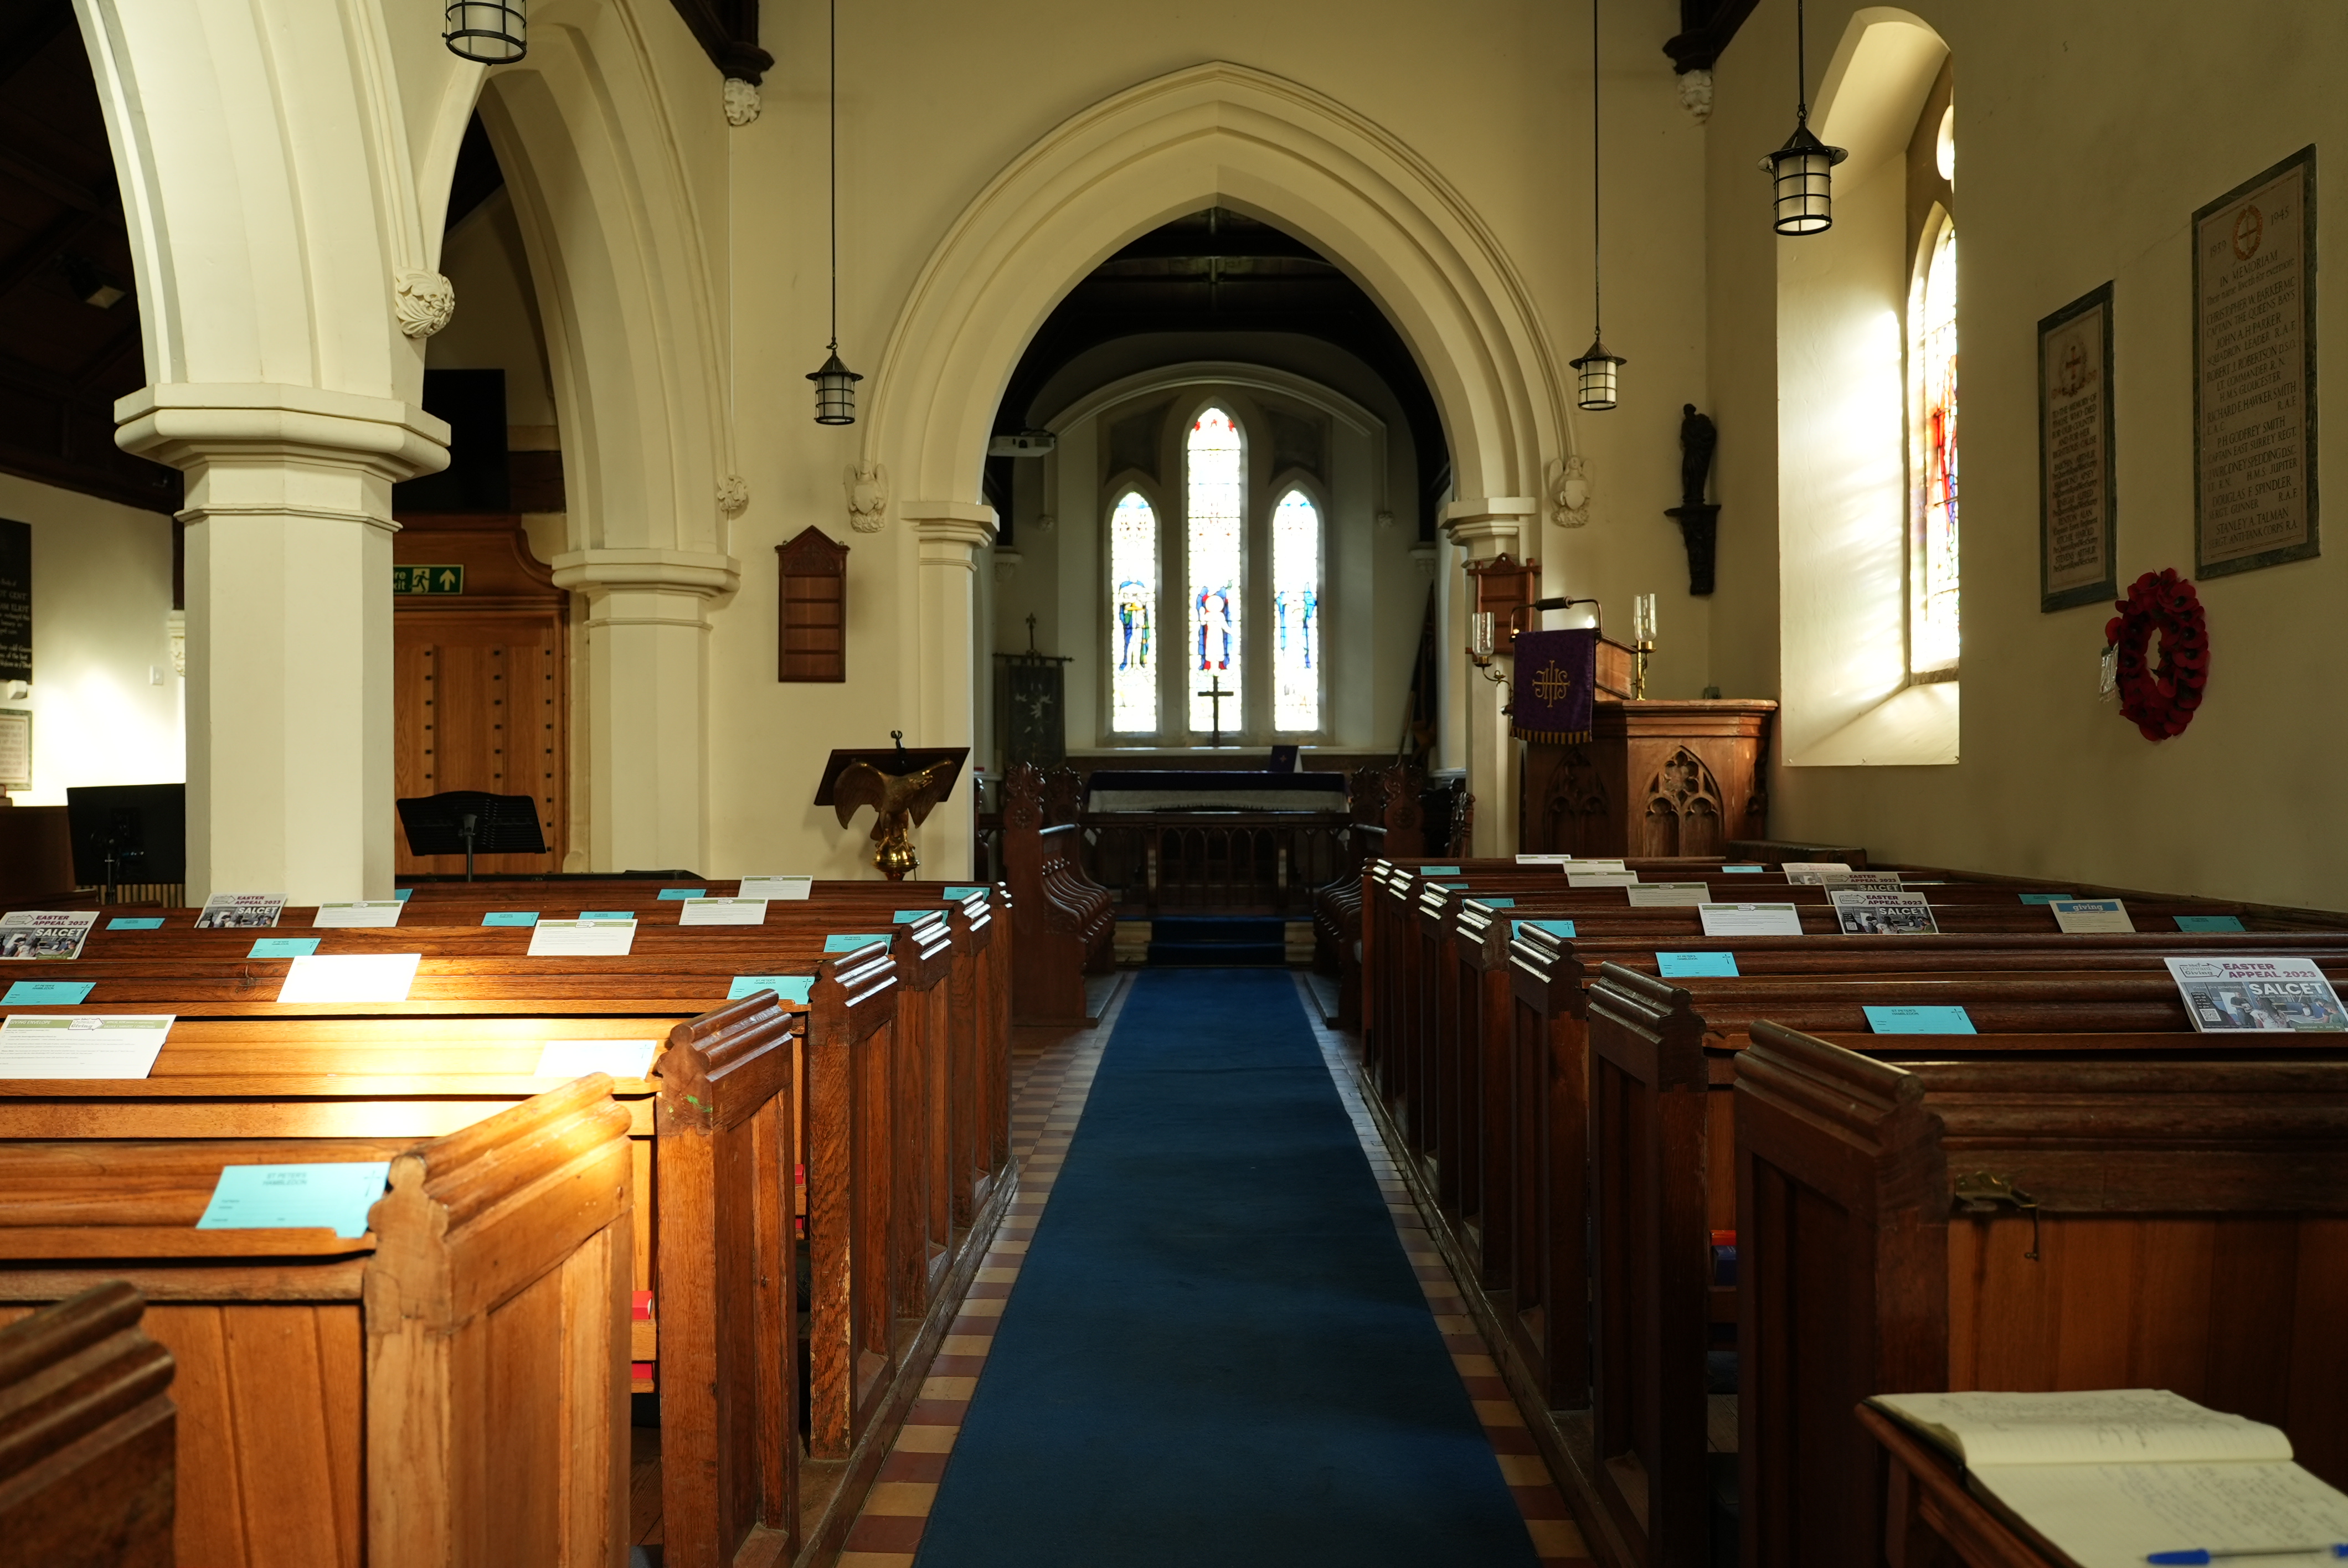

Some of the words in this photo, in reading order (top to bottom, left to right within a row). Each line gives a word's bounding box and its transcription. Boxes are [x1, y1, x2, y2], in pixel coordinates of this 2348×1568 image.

[2210, 240, 2226, 257] 1939
[2271, 205, 2289, 225] 1945
[2220, 276, 2228, 287] IN
[2233, 250, 2277, 279] MEMORIAM
[2267, 258, 2294, 276] evermore
[2206, 320, 2232, 338] CAPTAIN
[2234, 312, 2247, 324] THE
[2278, 290, 2295, 305] BAYS
[2207, 298, 2247, 326] CHRISTOPHER
[2257, 281, 2281, 303] PARKER
[2216, 329, 2236, 350] JOHN
[2254, 312, 2281, 333] PARKER
[2207, 344, 2240, 366] SQUADRON
[2244, 332, 2270, 350] LEADER
[2207, 363, 2230, 383] ROBERT
[2238, 345, 2277, 370] ROBERTSON
[2227, 363, 2267, 386] COMMANDER
[2239, 371, 2281, 395] GLOUCESTER
[2084, 404, 2097, 415] DIED
[2208, 404, 2236, 423] RICHARD
[2243, 390, 2271, 409] HAWKER
[2273, 381, 2296, 399] SMITH
[2081, 435, 2096, 447] CAUSE
[2229, 424, 2261, 443] GODFREY
[2263, 416, 2285, 433] SMITH
[2208, 447, 2232, 463] CAPTAIN
[2234, 443, 2248, 455] EAST
[2251, 434, 2276, 450] SURREY
[2220, 458, 2247, 476] RODNEY
[2248, 448, 2281, 467] SPEDDING
[2270, 458, 2297, 474] JUPITER
[2212, 488, 2245, 507] DOUGLAS
[2255, 476, 2291, 496] SPINDLER
[2231, 499, 2259, 514] GUNNER
[2216, 518, 2248, 535] STANLEY
[2257, 507, 2288, 522] TALMAN
[2263, 522, 2283, 536] CORPS
[394, 571, 406, 580] re
[35, 929, 85, 937] SALCET
[2249, 983, 2323, 996] SALCET
